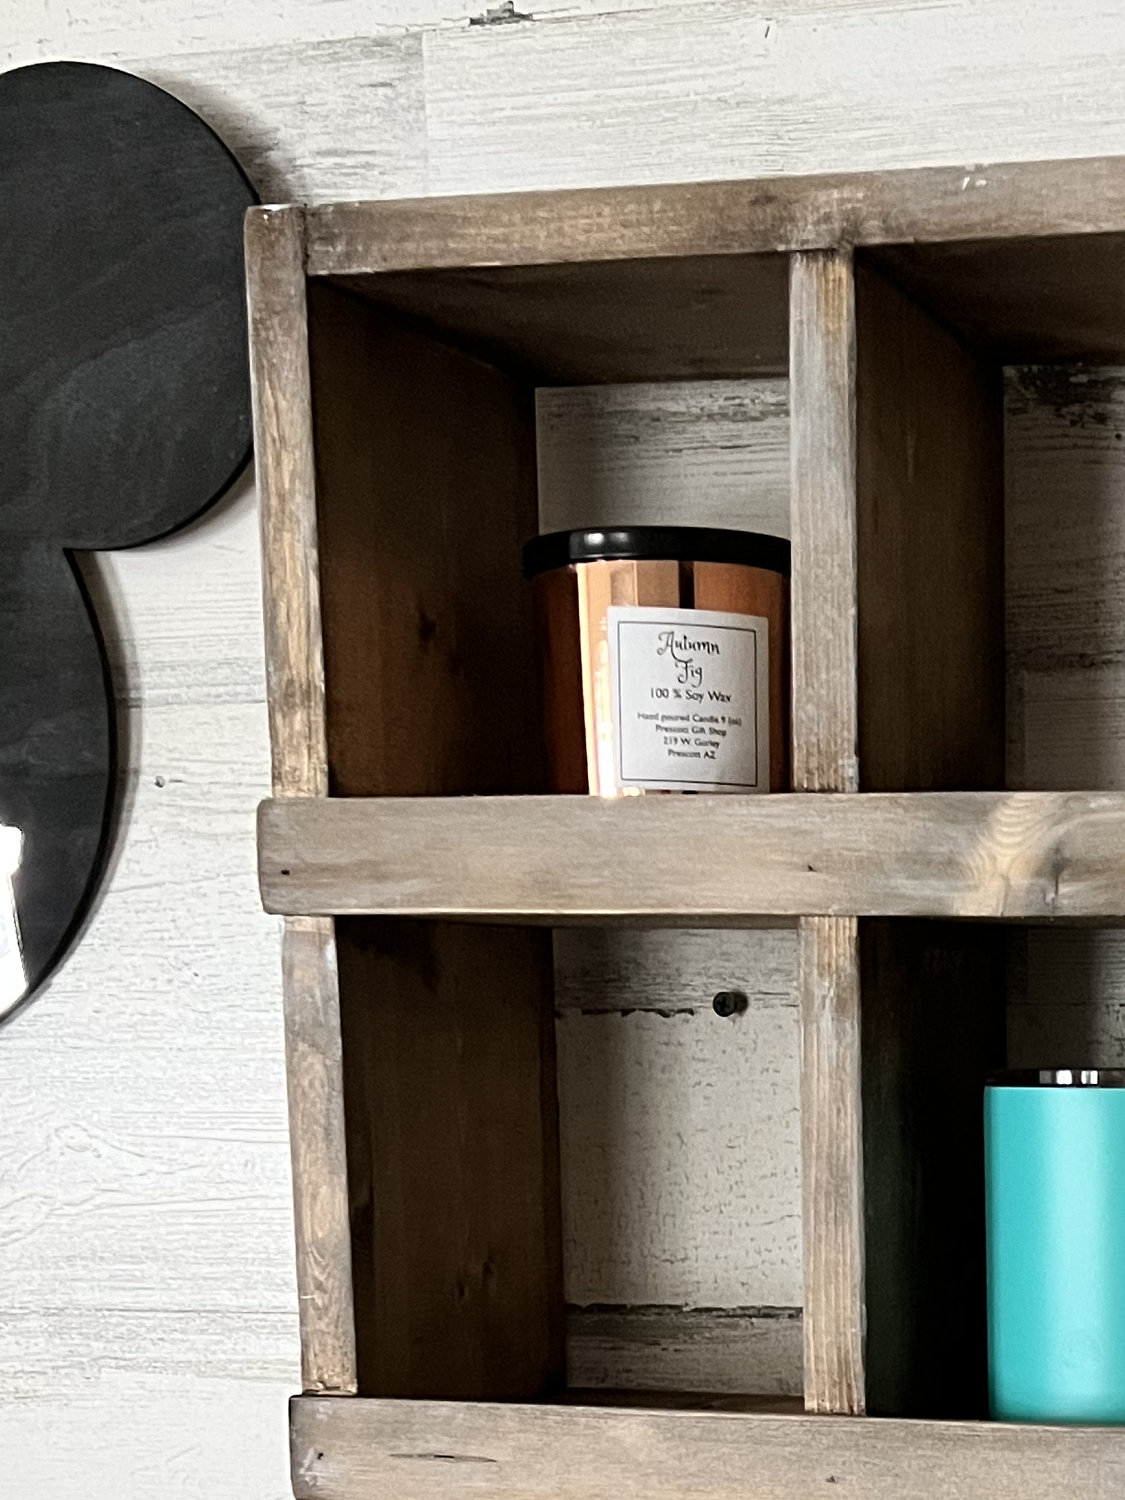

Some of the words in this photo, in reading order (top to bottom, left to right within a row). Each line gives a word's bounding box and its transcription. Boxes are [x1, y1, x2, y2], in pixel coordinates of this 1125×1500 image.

[657, 631, 720, 657] Autumn
[675, 658, 703, 688] Fig
[651, 687, 670, 699] 100
[672, 688, 682, 699] %
[685, 689, 704, 704] Soy
[708, 690, 732, 703] Wax
[703, 750, 716, 760] AZ
